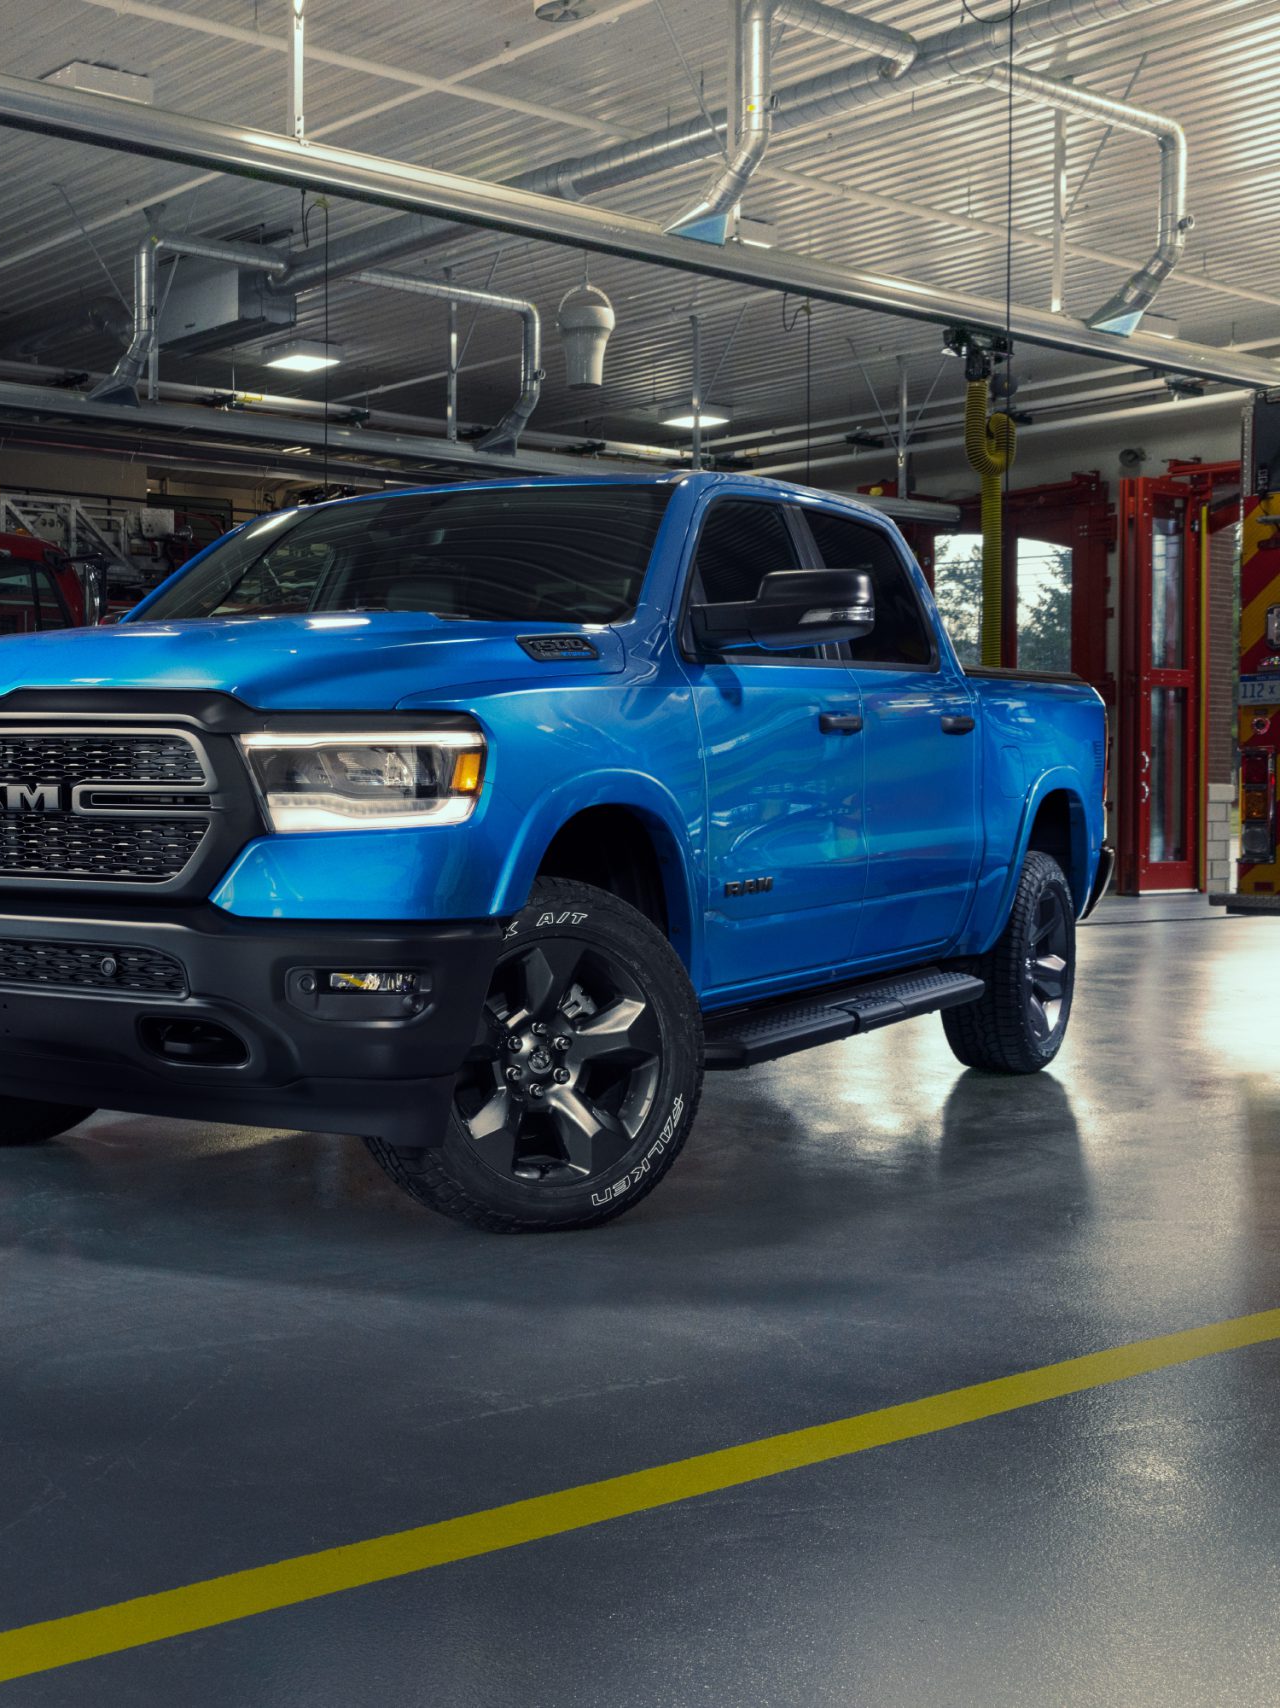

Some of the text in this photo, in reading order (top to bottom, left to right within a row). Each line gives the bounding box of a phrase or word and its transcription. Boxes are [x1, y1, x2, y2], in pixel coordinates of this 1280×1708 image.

[1241, 682, 1265, 699] 112
[724, 876, 773, 898] RAM
[535, 911, 589, 927] A/T
[591, 1093, 684, 1207] FALKEN
